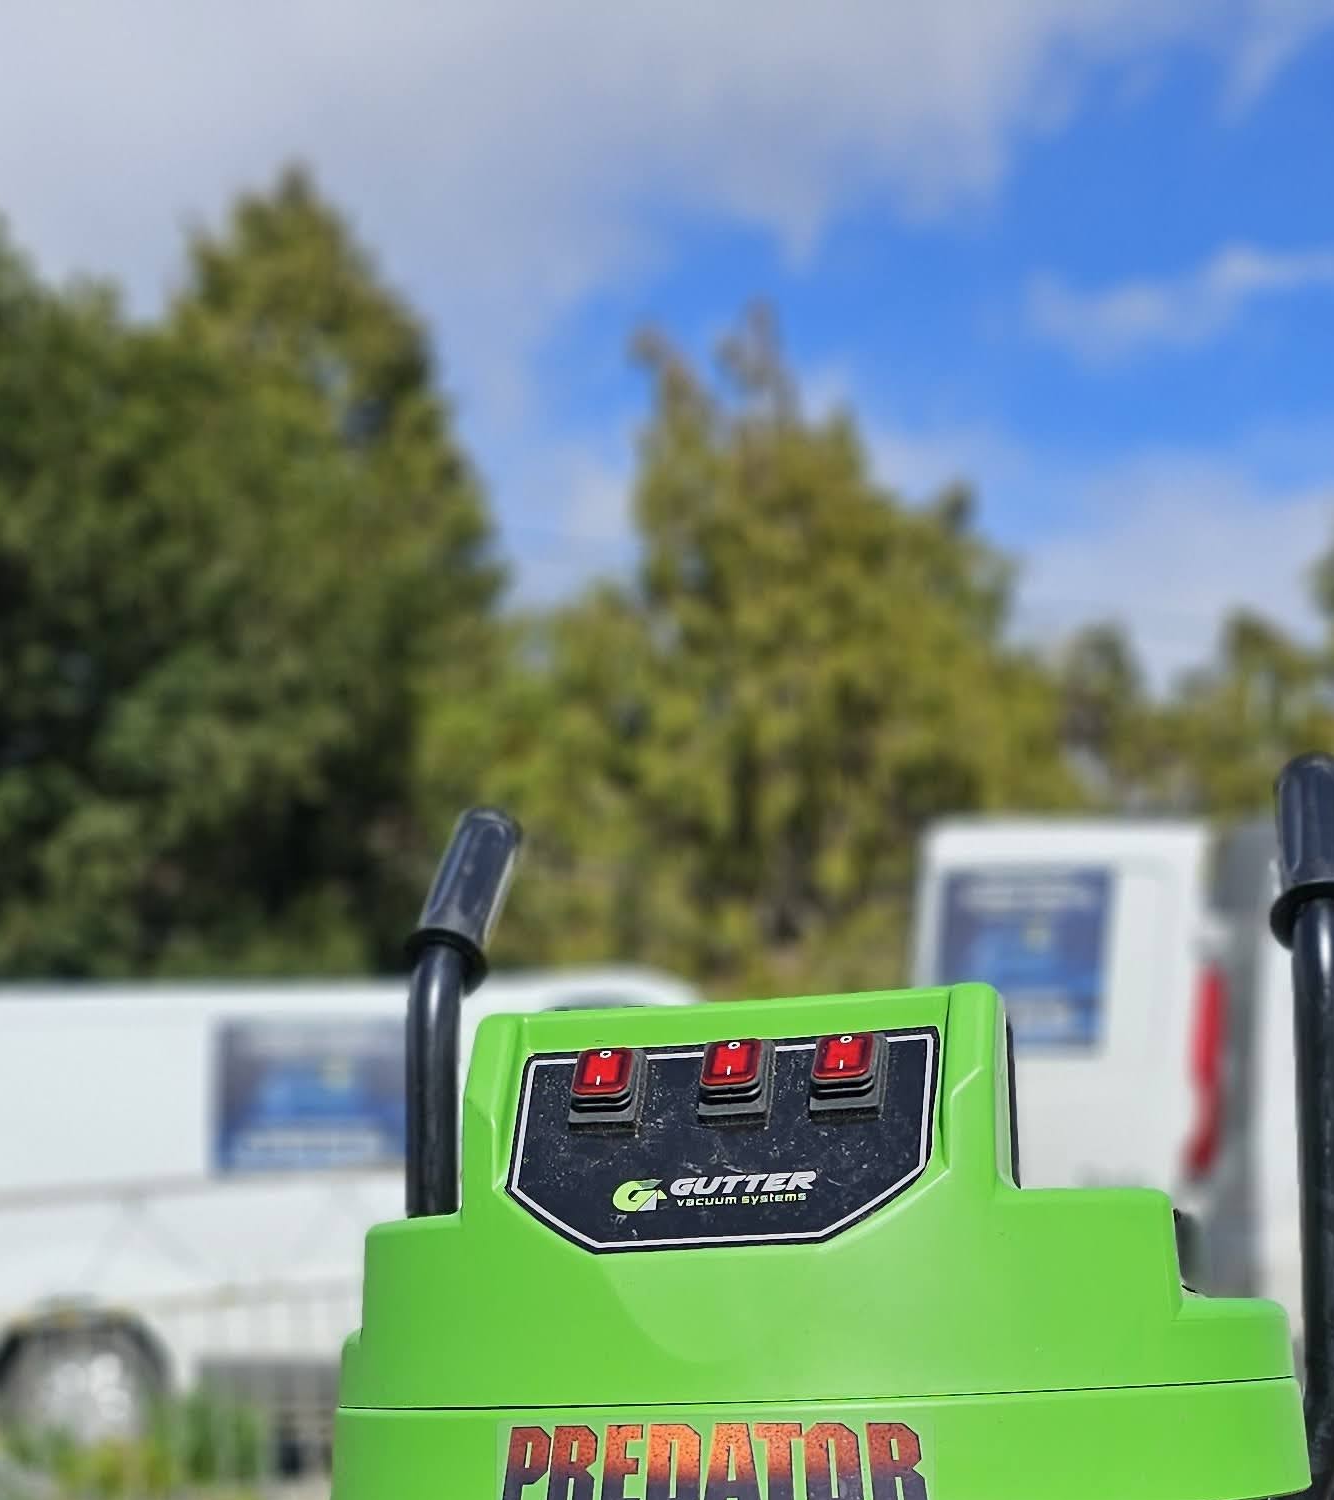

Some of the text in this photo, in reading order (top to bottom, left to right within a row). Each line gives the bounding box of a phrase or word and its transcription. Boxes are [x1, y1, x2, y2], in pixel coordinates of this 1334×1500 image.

[669, 1170, 817, 1196] GUTTER
[676, 1192, 807, 1208] vacuum systems
